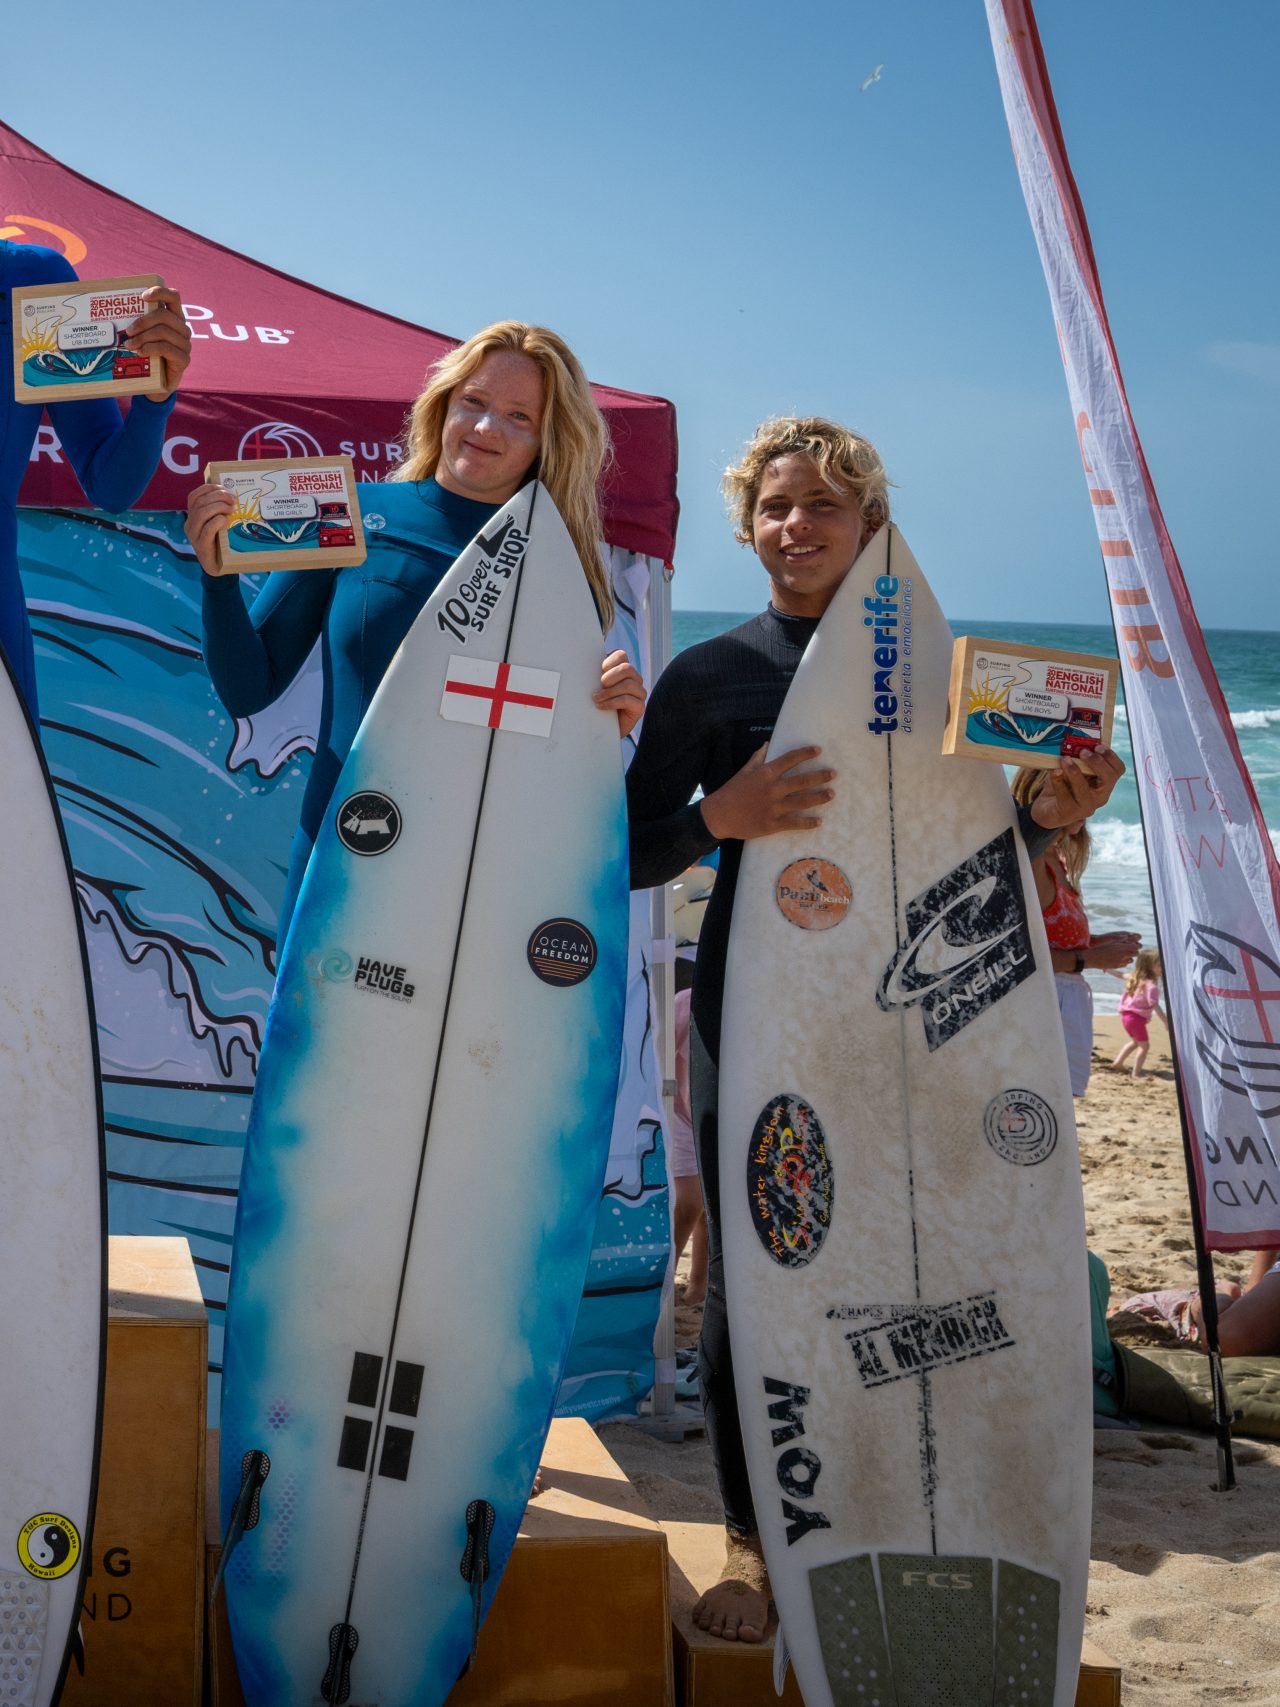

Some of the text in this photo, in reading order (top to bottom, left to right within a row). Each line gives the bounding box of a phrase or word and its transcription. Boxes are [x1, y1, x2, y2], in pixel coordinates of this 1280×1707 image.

[99, 295, 144, 309] ENGLISH
[91, 306, 144, 318] NATIONAL
[64, 330, 107, 340] SHORTBOARD
[72, 325, 98, 333] WINNER
[290, 482, 343, 491] NATIONAL
[297, 473, 343, 485] ENGLISH
[471, 528, 529, 633] SURF SHOP
[437, 559, 492, 643] 10 Over
[864, 575, 899, 735] tenerife
[901, 578, 913, 733] despierta emociones
[1046, 680, 1103, 696] NATIONAL
[1056, 671, 1104, 691] ENGLISH
[1015, 697, 1060, 709] SHORTBOARD
[1025, 692, 1052, 701] WINNER
[1034, 707, 1051, 715] BOYS
[539, 936, 588, 953] OCEAN
[535, 947, 589, 963] FREEDOM
[358, 957, 406, 982] WAVE
[355, 970, 415, 997] PLUGS
[754, 1105, 785, 1164] kingdom
[753, 1176, 770, 1220] water
[762, 1376, 831, 1546] YOW
[40, 1516, 59, 1524] Surf
[60, 1520, 77, 1549] Designs
[28, 1563, 56, 1577] Hawaii
[902, 1571, 973, 1590] FCS
